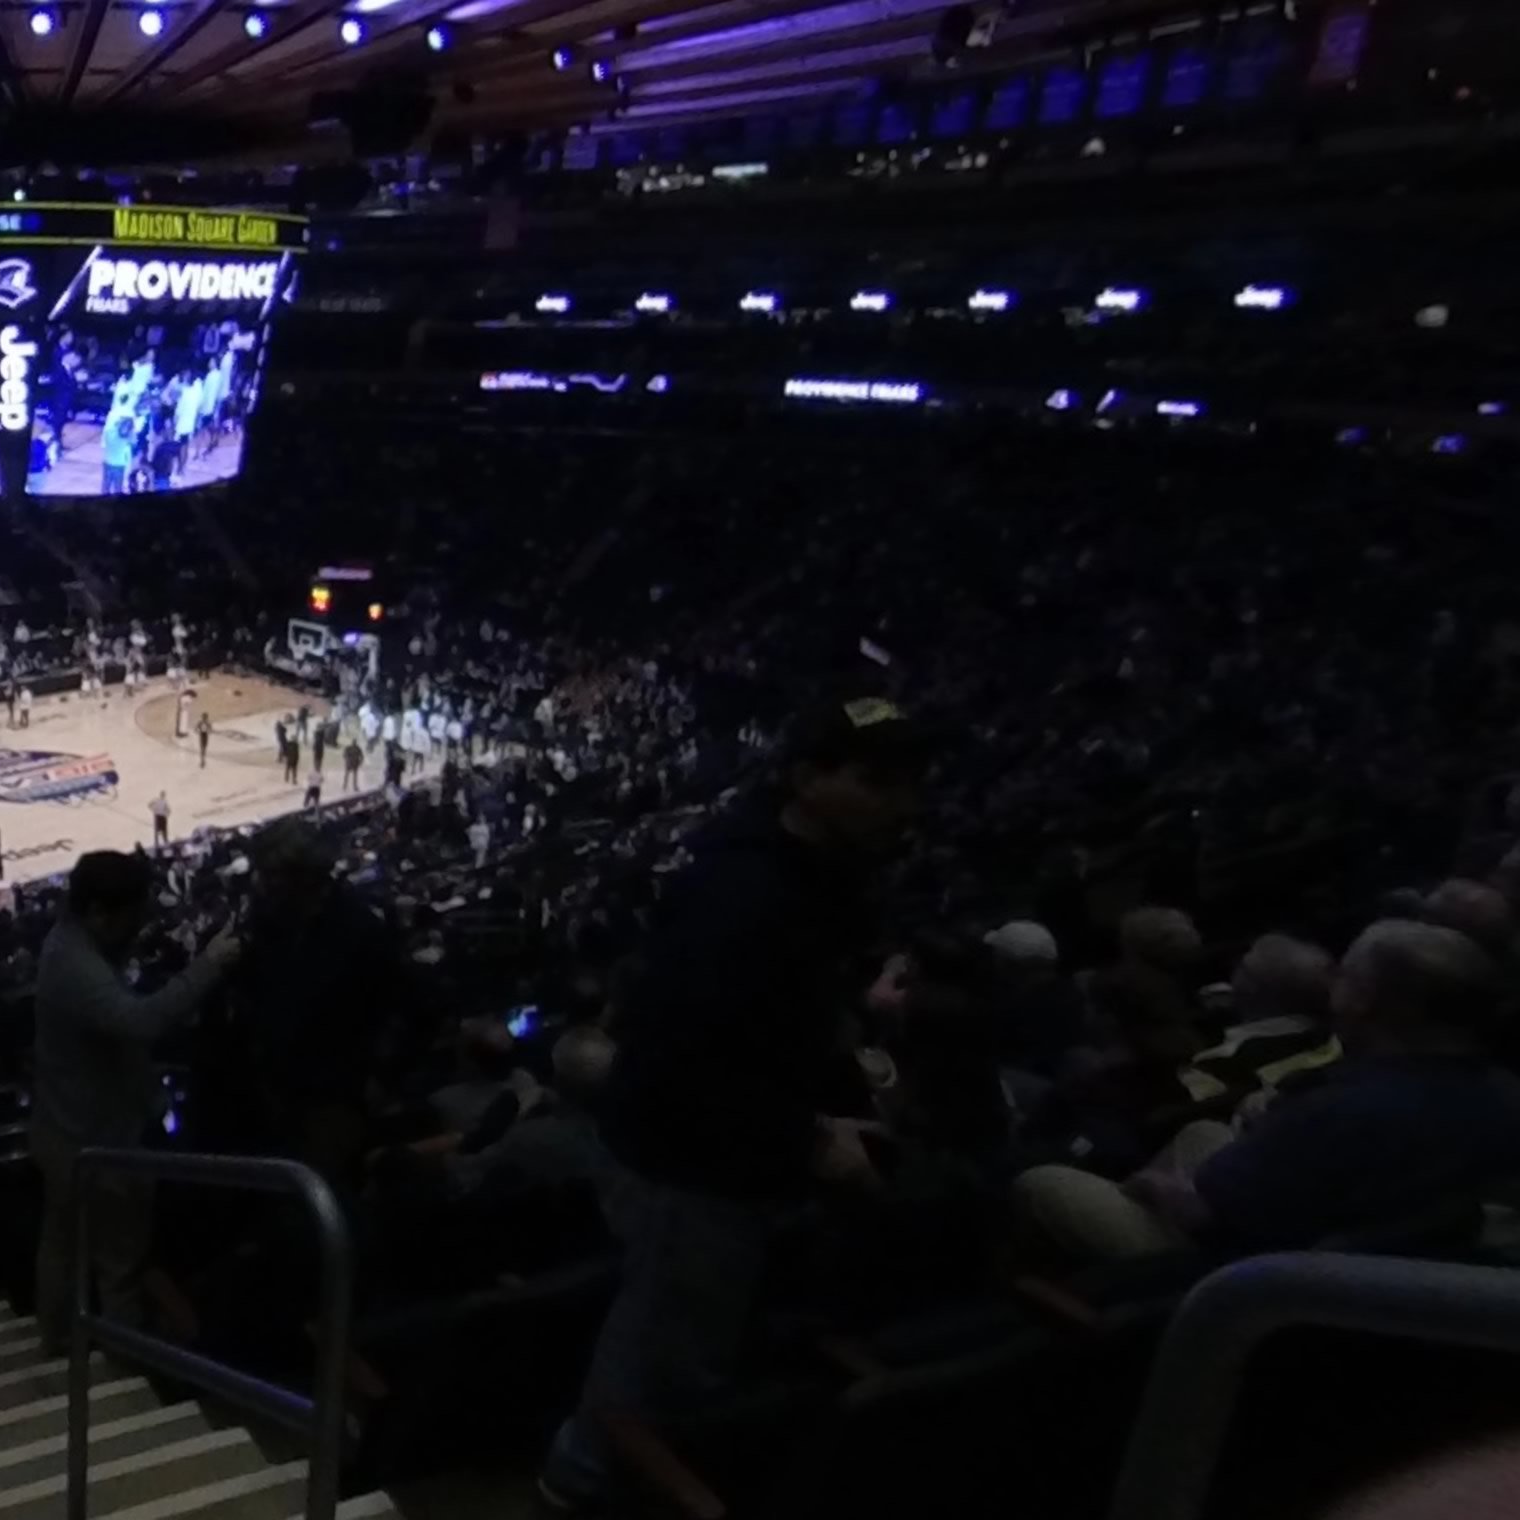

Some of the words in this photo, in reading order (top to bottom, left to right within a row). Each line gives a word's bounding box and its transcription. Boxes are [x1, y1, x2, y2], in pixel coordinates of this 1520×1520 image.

[114, 208, 183, 239] MADISON
[187, 211, 235, 242] SQUARE
[88, 259, 278, 300] PROVIDENCE
